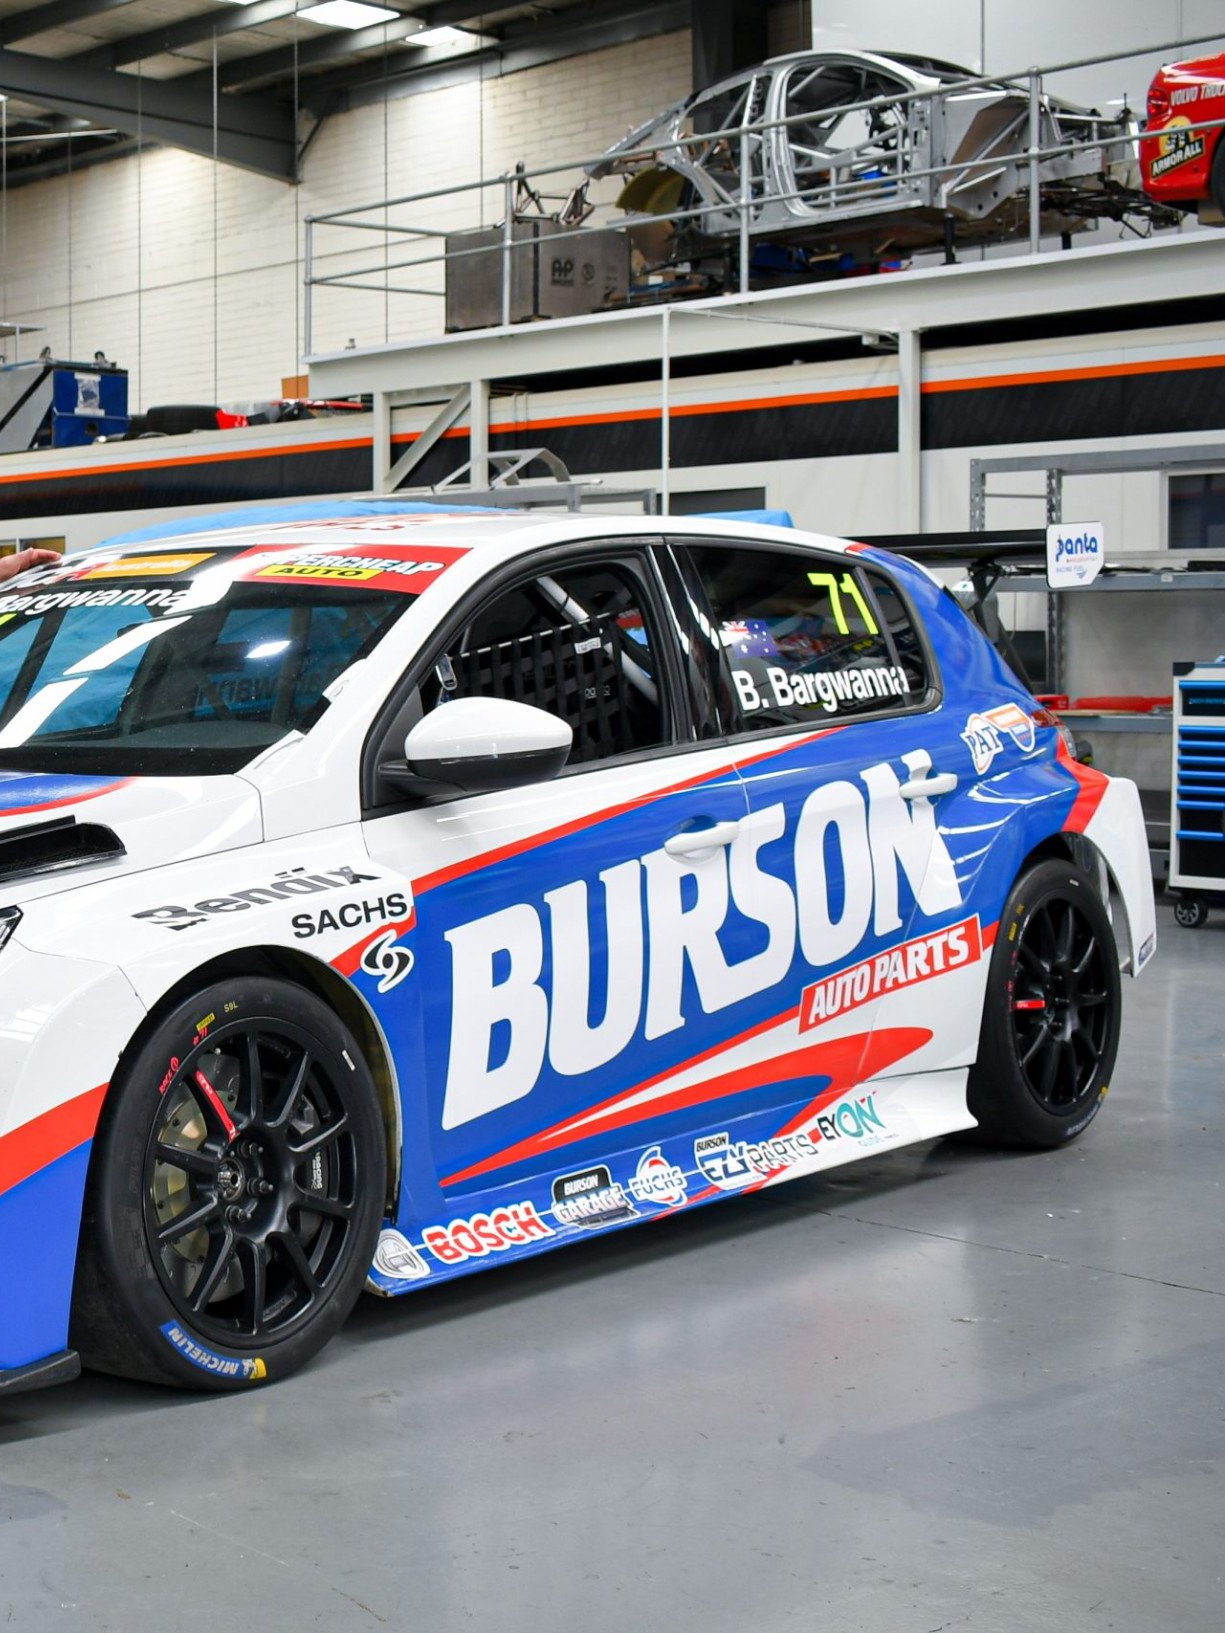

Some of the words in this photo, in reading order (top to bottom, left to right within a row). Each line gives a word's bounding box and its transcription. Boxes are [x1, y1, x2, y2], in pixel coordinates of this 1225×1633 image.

[1171, 86, 1199, 107] VOLVO
[1152, 148, 1185, 177] ARMOR
[1184, 141, 1202, 160] ALL
[1055, 532, 1099, 562] panta
[278, 567, 363, 577] AUTO
[807, 573, 879, 635] 71
[732, 670, 770, 711] B.
[767, 665, 911, 713] Bargwanna
[965, 726, 1001, 759] PAT
[291, 892, 408, 939] SACHS
[442, 749, 962, 1131] BURSON
[808, 955, 874, 1025] AUTO
[872, 926, 971, 998] PARTS
[696, 1135, 727, 1152] BURSON
[747, 1134, 819, 1170] PARTS
[564, 1174, 598, 1196] BURSON
[631, 1170, 684, 1197] FUCHS
[556, 1187, 627, 1220] GARAGE
[426, 1206, 548, 1261] BOSCH
[168, 1327, 240, 1375] MICHELIN
